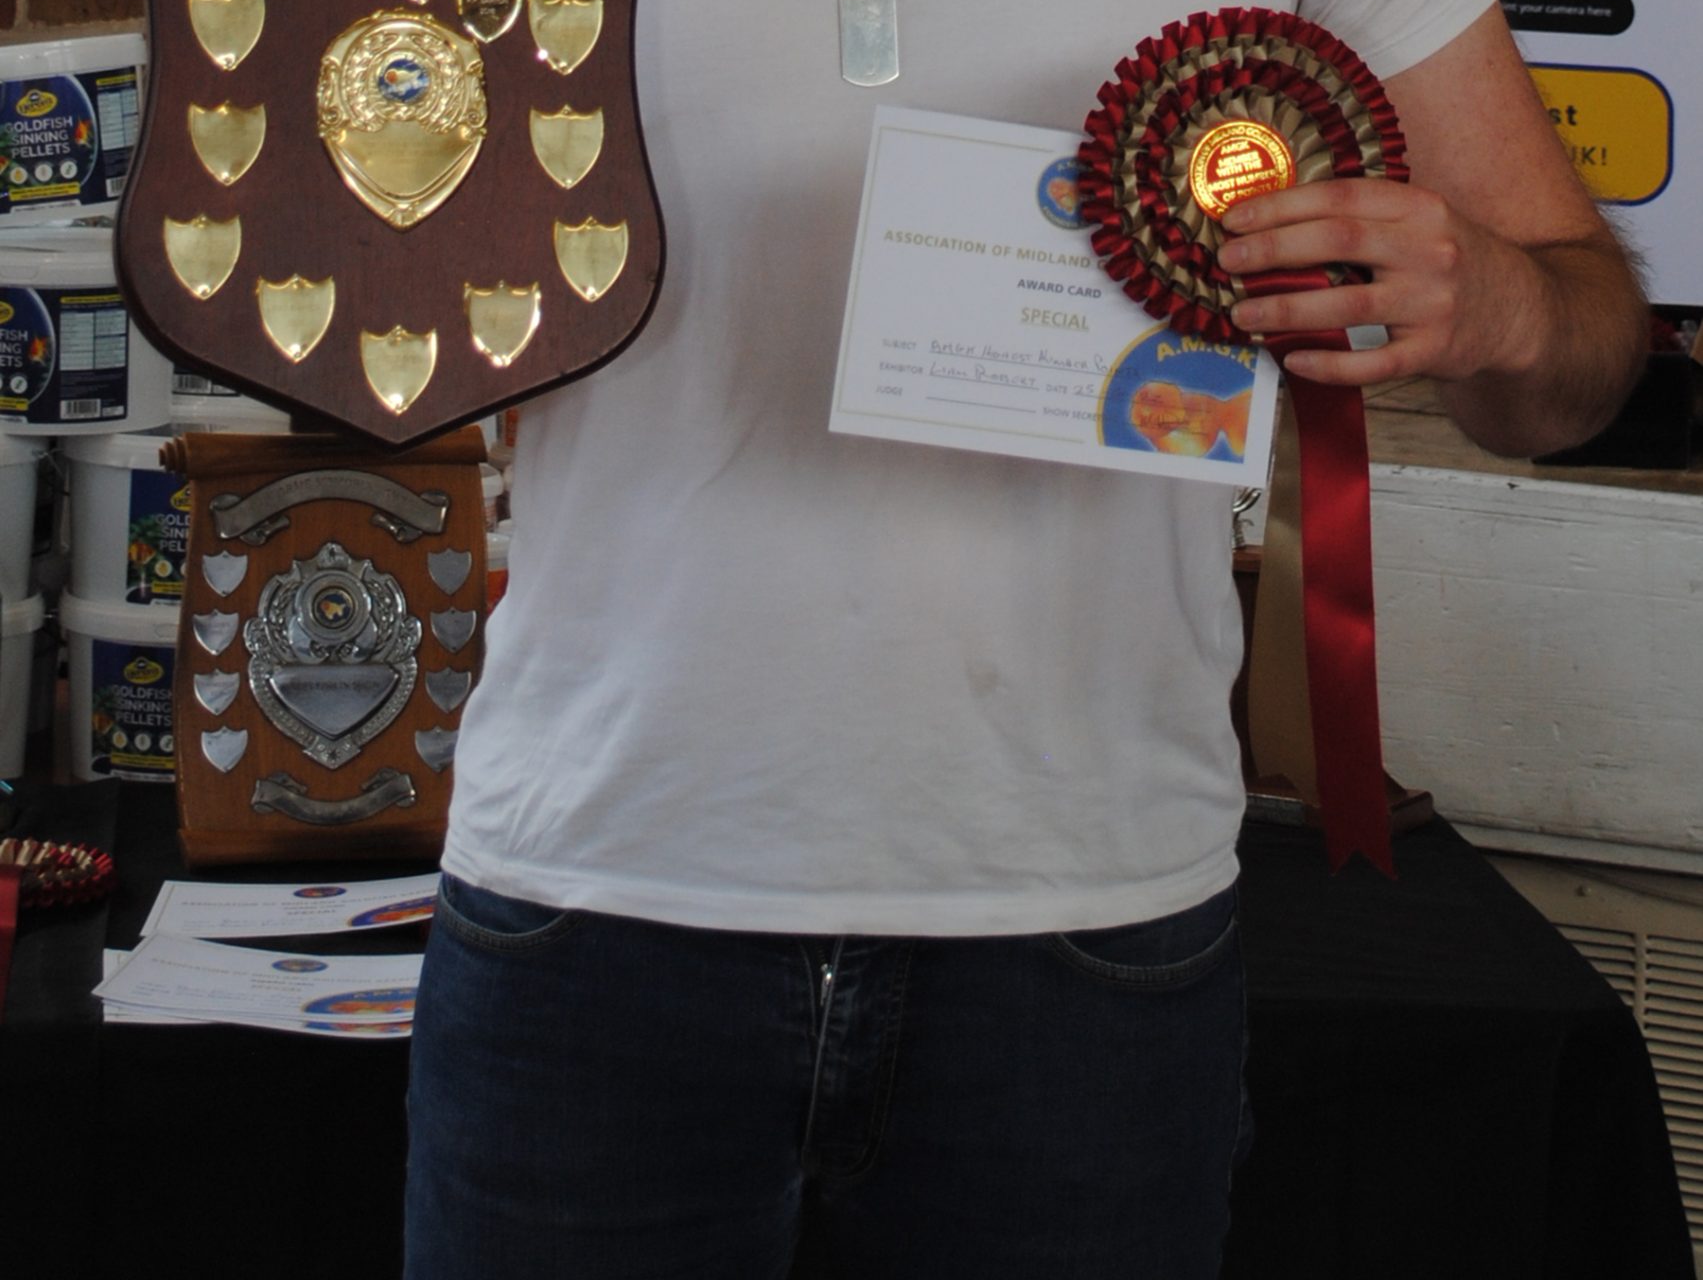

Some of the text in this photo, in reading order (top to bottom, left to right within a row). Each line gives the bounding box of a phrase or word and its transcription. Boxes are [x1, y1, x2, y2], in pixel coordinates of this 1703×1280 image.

[5, 115, 74, 133] GOLDFISH
[11, 129, 69, 146] SINKING
[11, 141, 71, 159] PELLETS
[883, 229, 987, 255] ASSOCIATION
[991, 244, 1012, 258] OF
[1016, 247, 1091, 270] MIDLAND
[1017, 278, 1102, 299] AWARD CARD
[1021, 306, 1090, 330] SPECIAL
